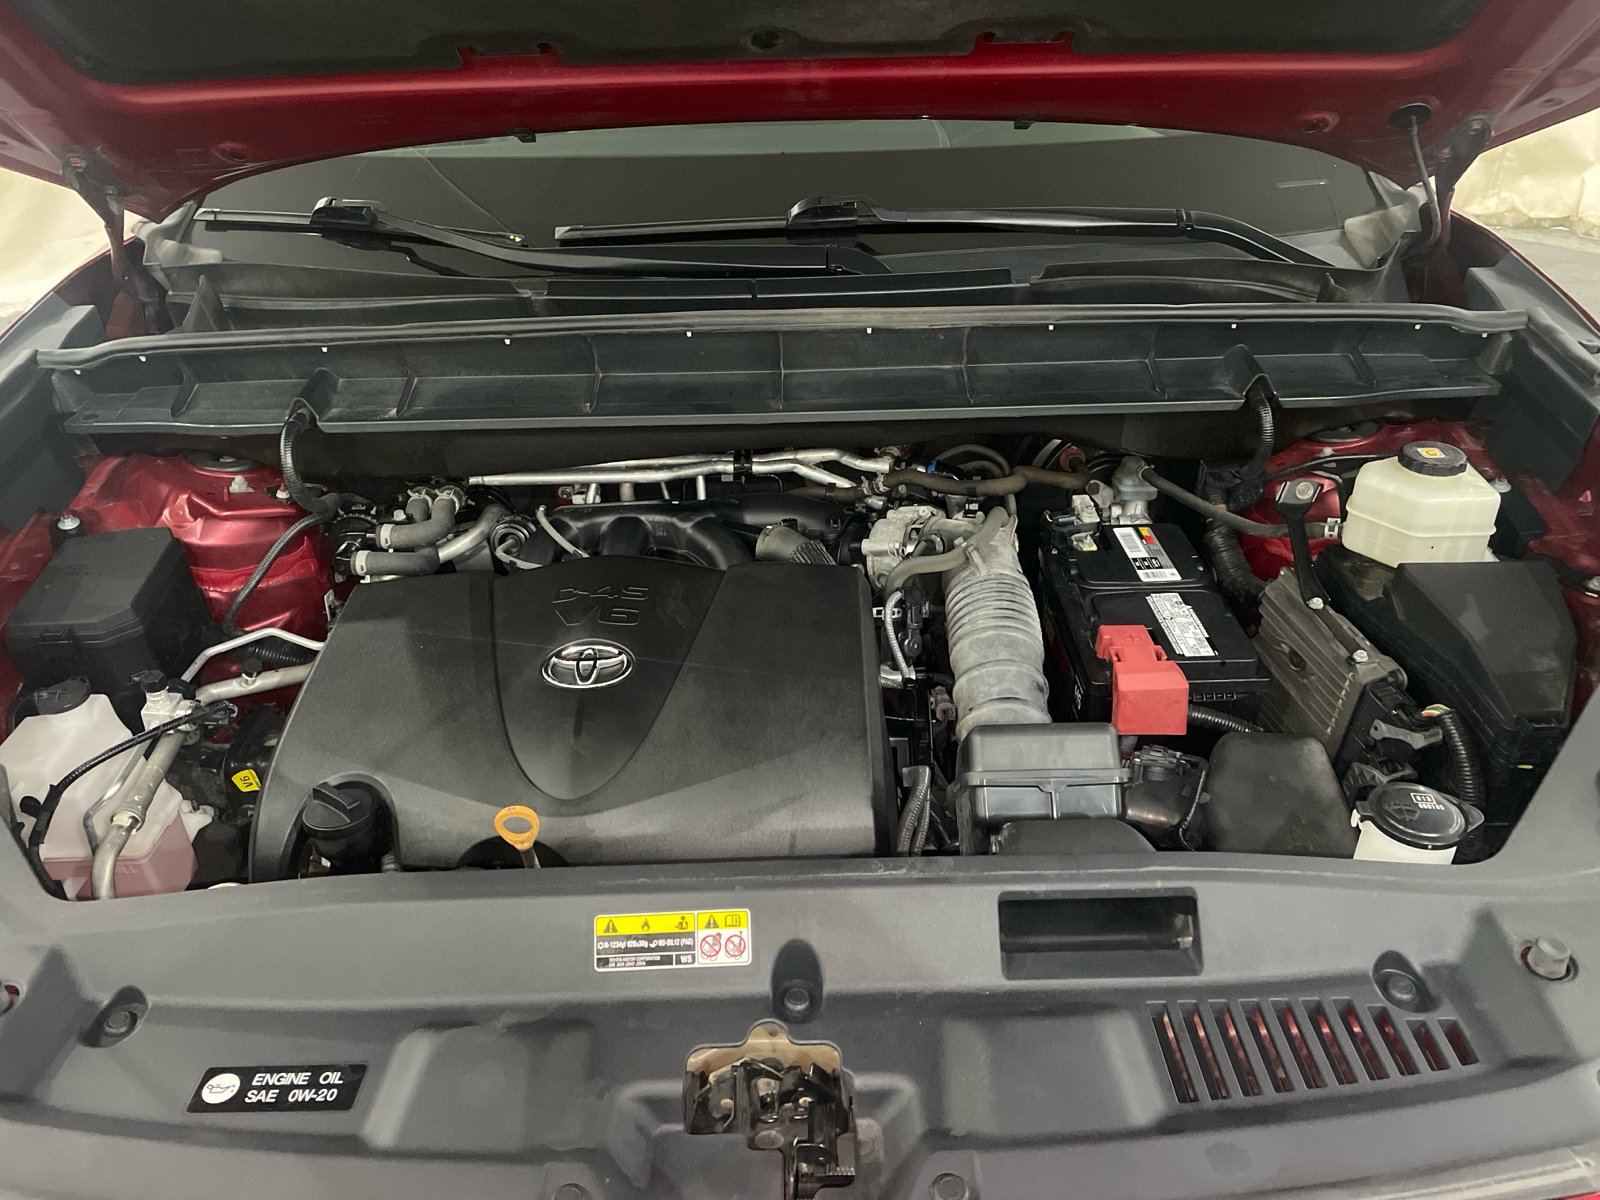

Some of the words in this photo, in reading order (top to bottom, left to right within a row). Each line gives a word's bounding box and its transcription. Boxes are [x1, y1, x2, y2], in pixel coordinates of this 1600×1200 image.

[555, 605, 640, 626] V6
[680, 954, 693, 964] WS
[251, 1072, 311, 1086] ENGINE
[318, 1071, 344, 1085] OIL
[244, 1089, 279, 1103] SAE
[287, 1088, 338, 1103] 0W-20
